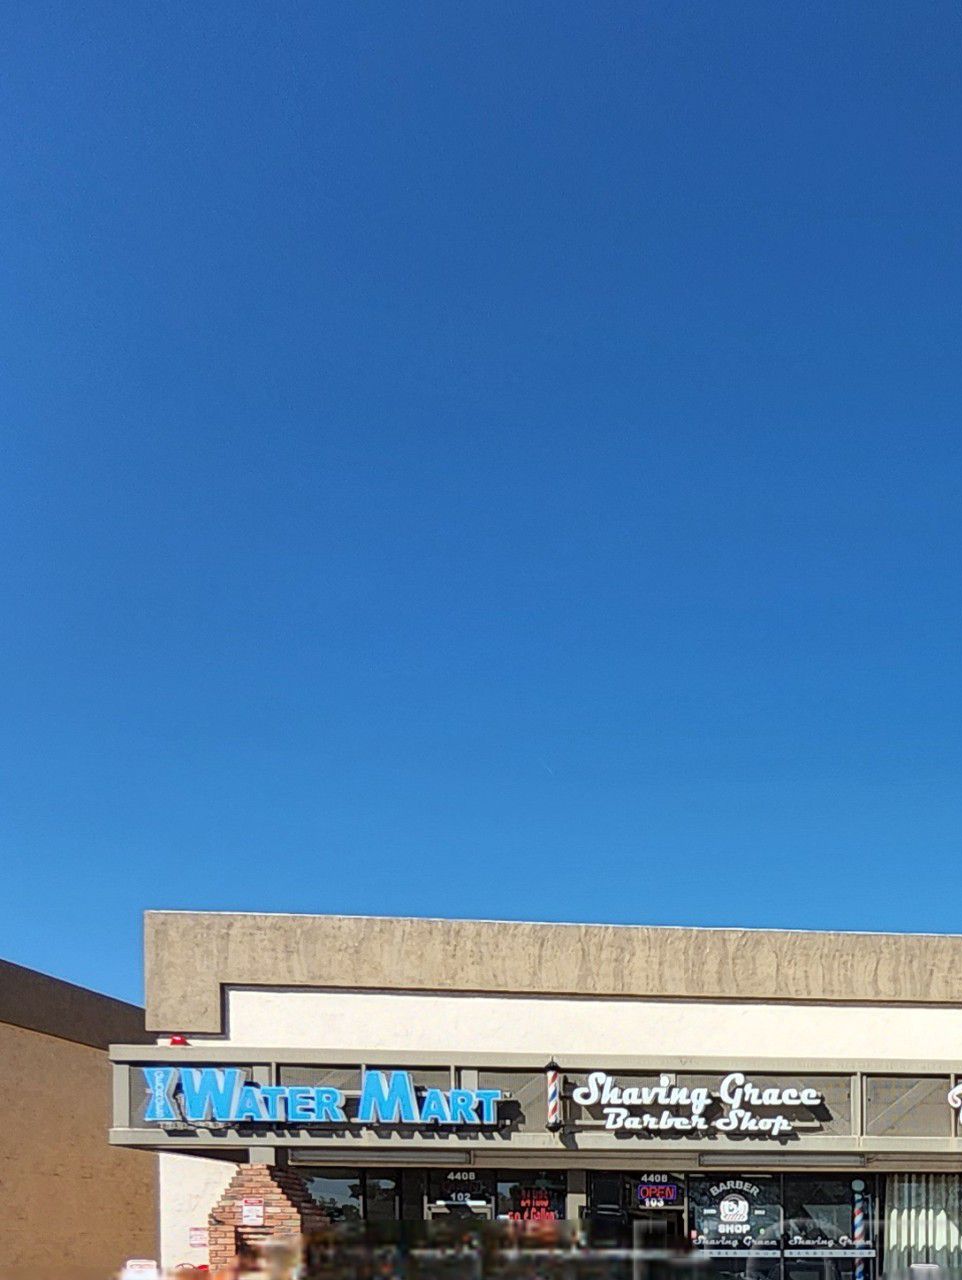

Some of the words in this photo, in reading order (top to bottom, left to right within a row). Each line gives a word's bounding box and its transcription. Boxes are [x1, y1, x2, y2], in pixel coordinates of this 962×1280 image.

[180, 1067, 345, 1123] WATER
[359, 1070, 502, 1125] MART
[572, 1071, 712, 1115] Shaving
[720, 1072, 822, 1107] Grace
[602, 1108, 710, 1132] Barber
[710, 1109, 792, 1136] Shop
[447, 1171, 476, 1180] 4408
[641, 1173, 668, 1182] 4408
[640, 1187, 675, 1198] OPEN
[709, 1180, 761, 1200] BARBER
[450, 1192, 471, 1202] 102
[644, 1198, 665, 1208] 103
[717, 1223, 751, 1235] SHOP
